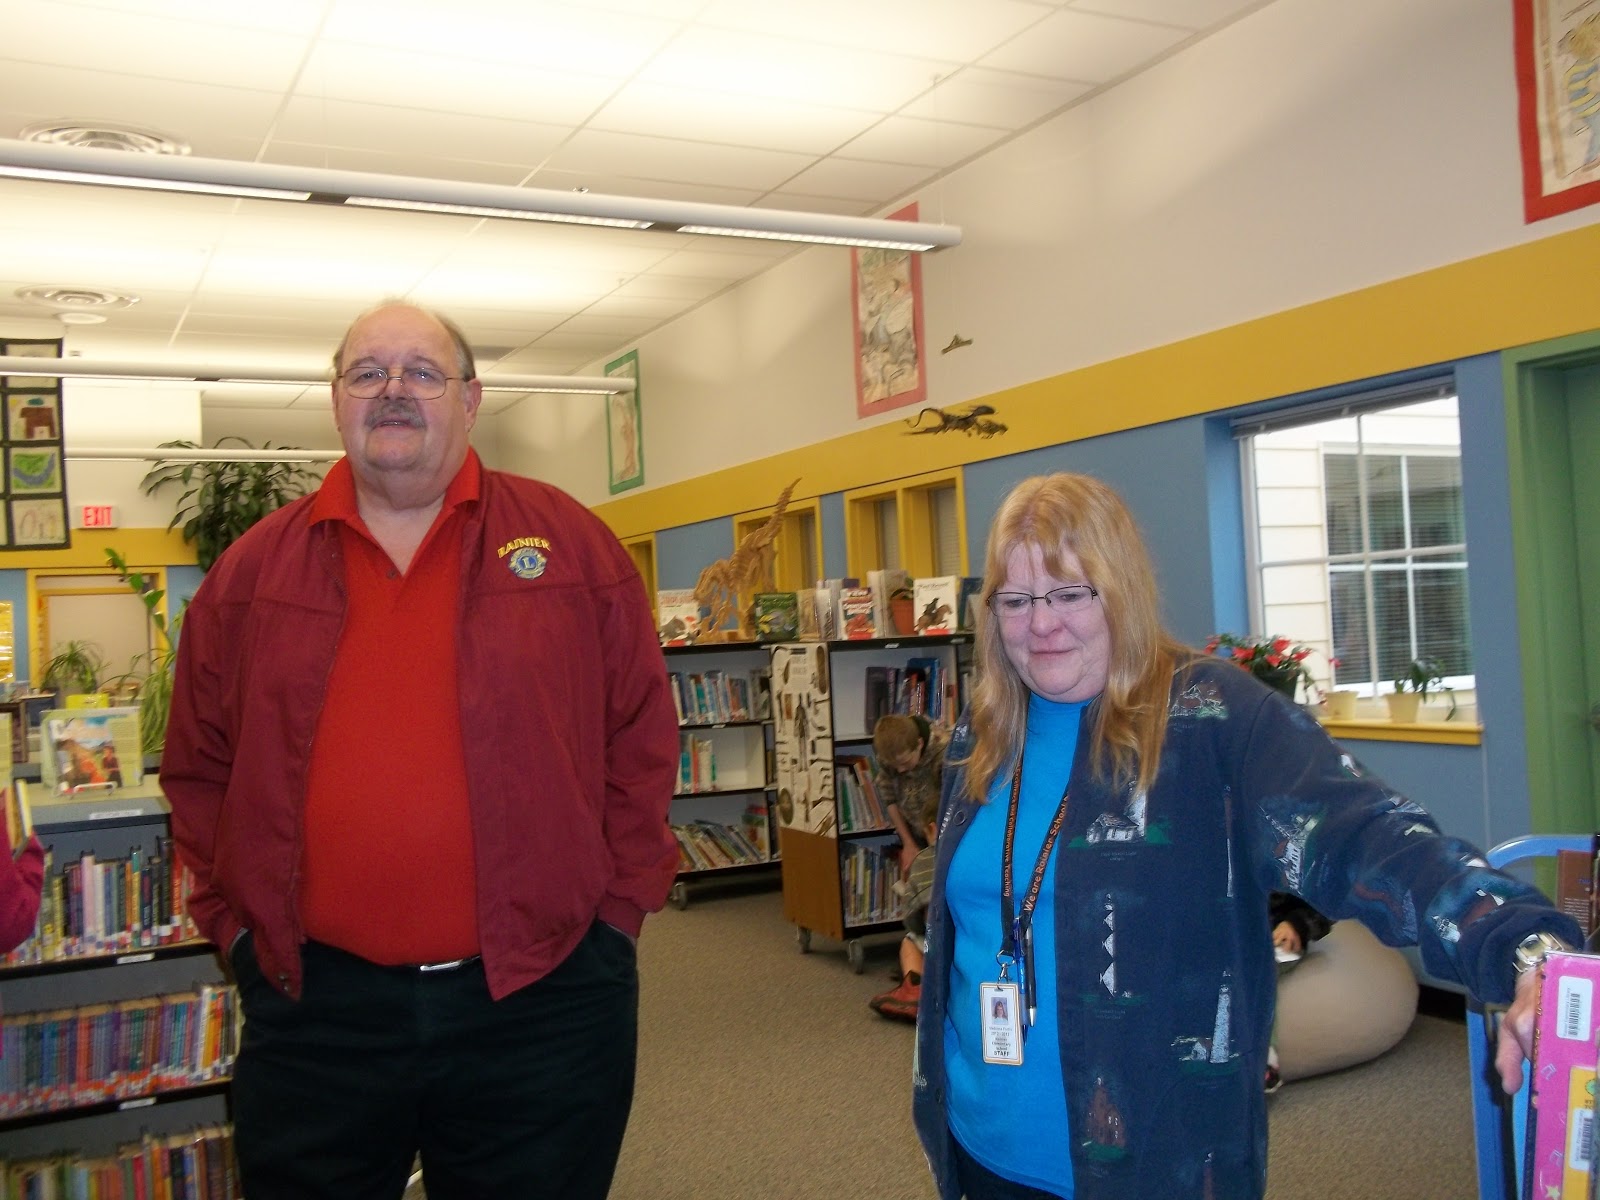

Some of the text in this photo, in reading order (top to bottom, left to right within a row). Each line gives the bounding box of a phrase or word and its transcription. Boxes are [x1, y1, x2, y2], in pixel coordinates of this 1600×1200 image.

[84, 506, 112, 526] EXIT
[497, 536, 551, 558] RAINIER
[1004, 817, 1014, 863] Collaborative
[1003, 864, 1011, 897] Teaching
[1023, 895, 1036, 911] We
[1031, 876, 1041, 893] are
[1036, 838, 1053, 874] Rainier
